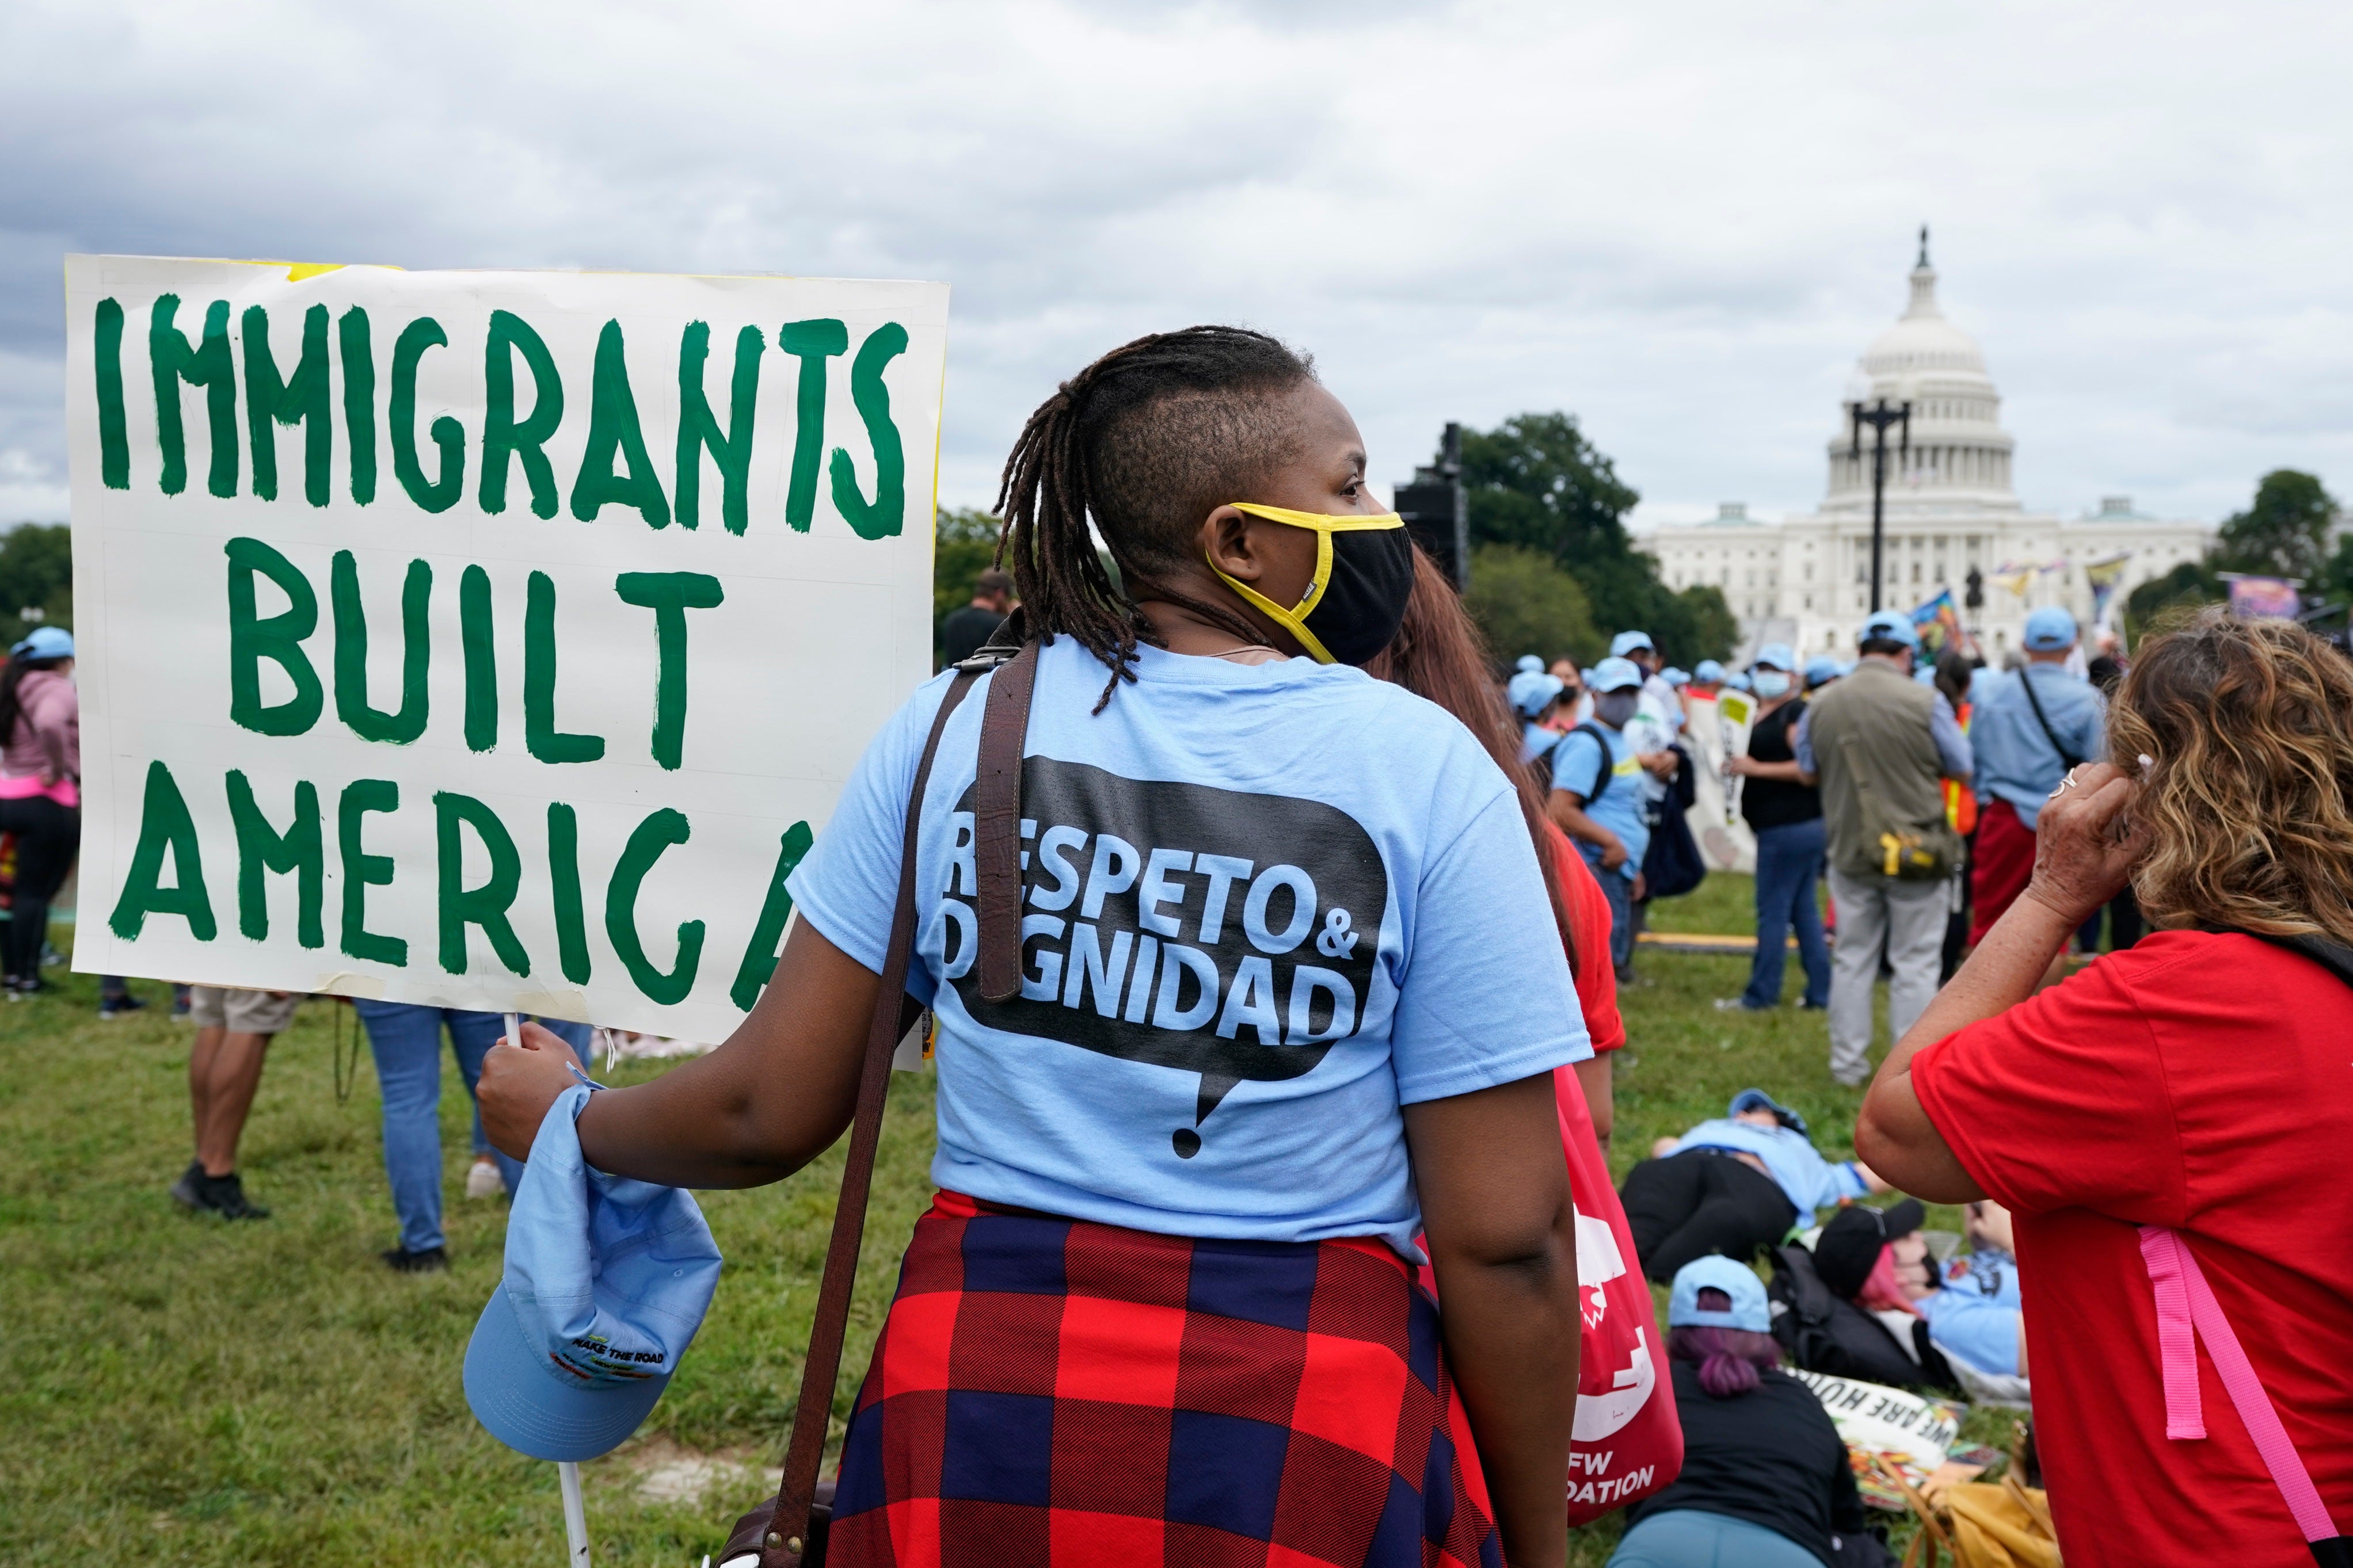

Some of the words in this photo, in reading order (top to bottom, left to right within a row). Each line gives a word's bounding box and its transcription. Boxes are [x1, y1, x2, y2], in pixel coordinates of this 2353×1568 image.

[95, 292, 909, 541] IMMIGRANTS
[224, 536, 725, 771] BUILT
[941, 898, 1357, 1046] DGNIDAD
[572, 1338, 608, 1355] MAKE
[609, 1346, 634, 1361] THE
[634, 1351, 664, 1364] ROAD
[1866, 1397, 1925, 1428] ARE
[1917, 1417, 1952, 1448] WE
